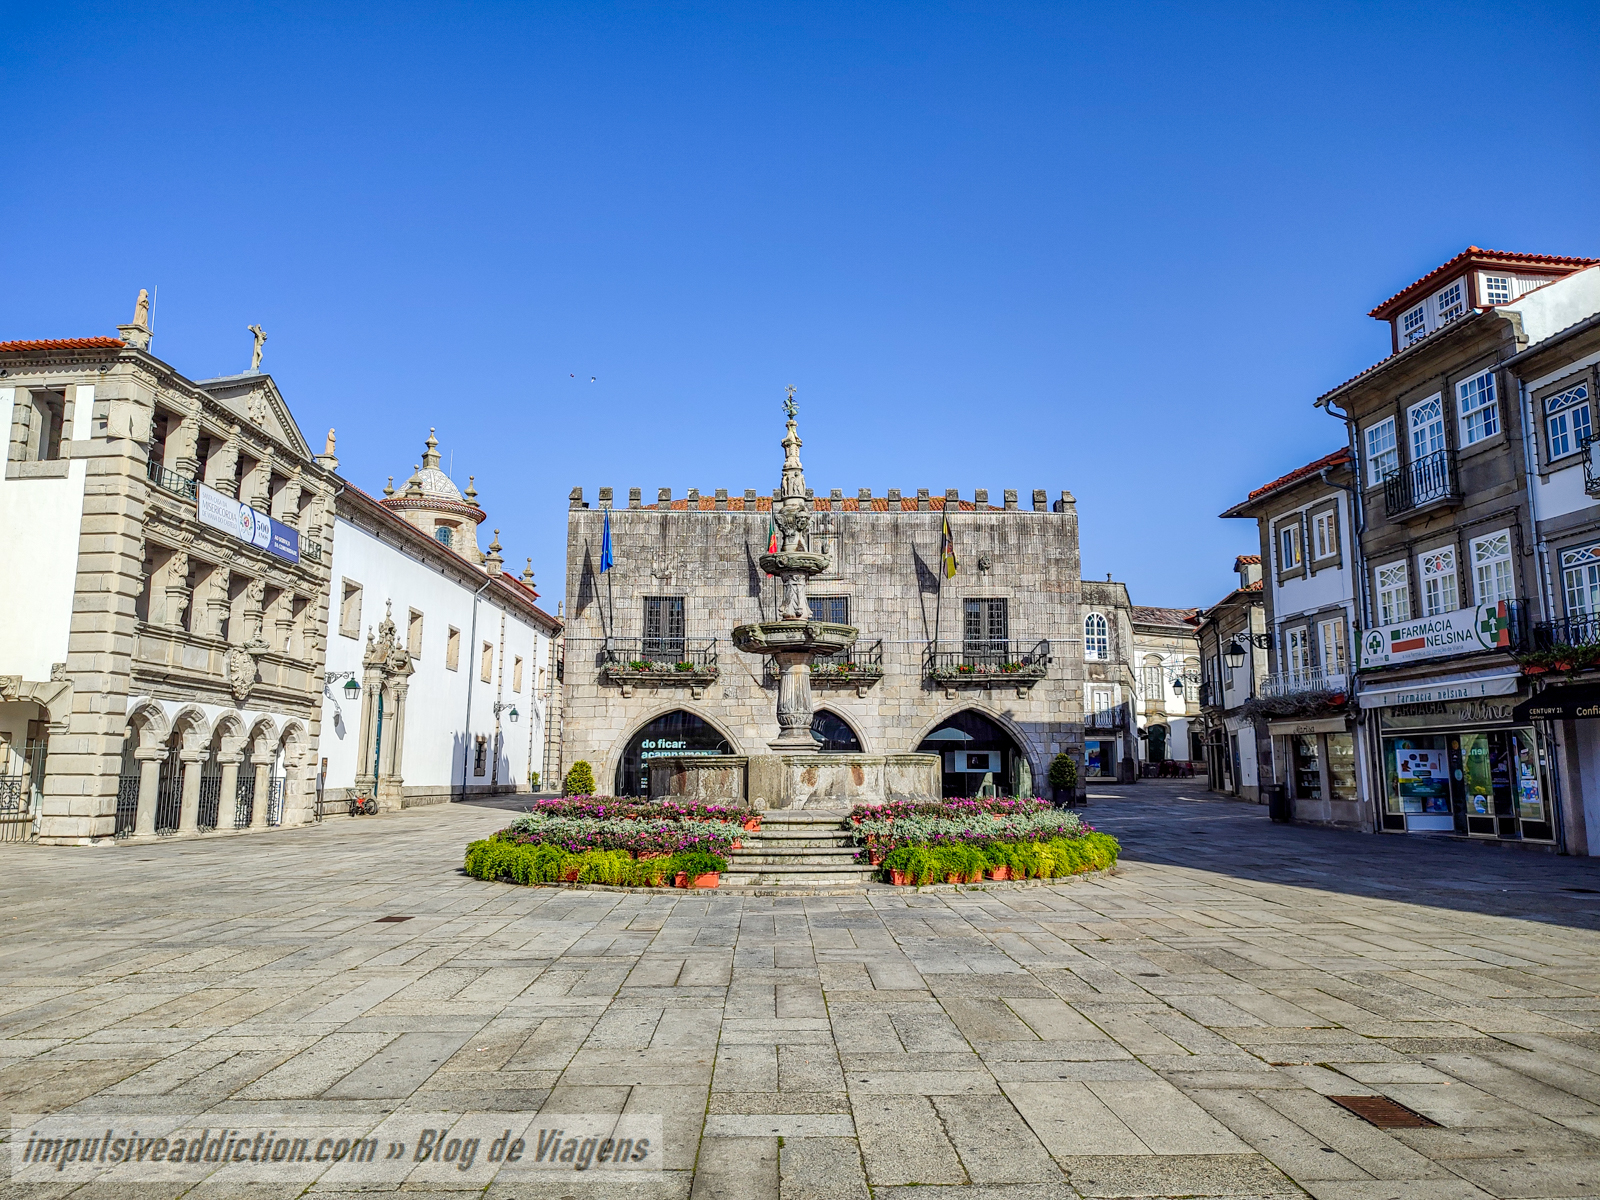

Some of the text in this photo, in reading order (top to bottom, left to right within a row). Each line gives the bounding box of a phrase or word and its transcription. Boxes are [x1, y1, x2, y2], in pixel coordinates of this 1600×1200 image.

[256, 520, 270, 535] 500
[1401, 619, 1453, 639] FARMÁCIA
[1426, 629, 1474, 648] NELSINA
[1397, 687, 1468, 704] farmácia nelsina
[1529, 707, 1556, 715] CENTURY
[1576, 705, 1600, 716] Confi
[641, 739, 687, 749] do ficar:
